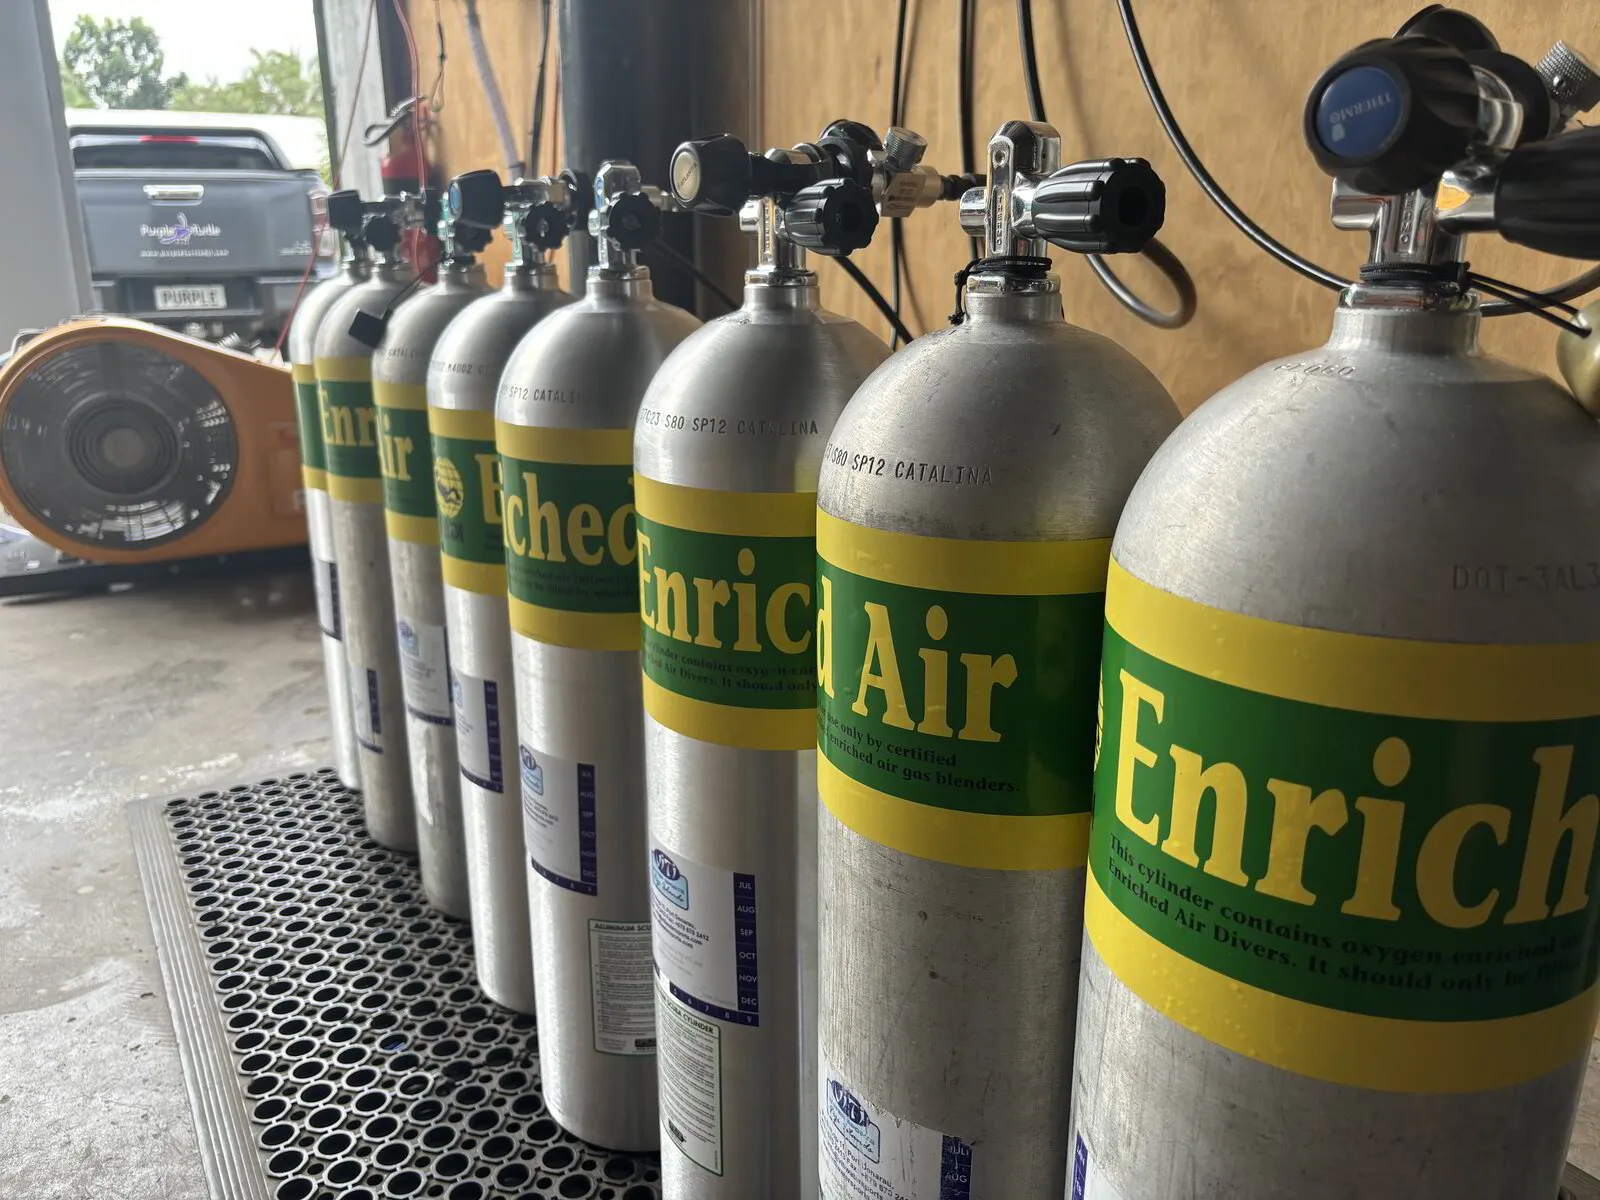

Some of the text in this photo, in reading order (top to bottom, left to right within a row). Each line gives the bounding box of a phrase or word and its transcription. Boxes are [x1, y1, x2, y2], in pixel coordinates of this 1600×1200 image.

[163, 289, 218, 307] PURPLE
[665, 414, 685, 430] S80
[692, 417, 727, 434] SP12
[737, 419, 819, 436] CATALINA
[852, 453, 884, 476] SP12
[895, 461, 993, 485] CATALINA
[637, 528, 812, 655] Enric
[681, 653, 733, 674] contains
[852, 601, 1019, 743] Air
[722, 676, 733, 688] It
[737, 678, 783, 692] should
[841, 723, 864, 744] only
[867, 732, 884, 752] by
[887, 743, 957, 768] certified
[830, 736, 1021, 793] enriched air gas blenders.
[1114, 668, 1600, 930] Enrich
[738, 881, 752, 890] JUL
[1110, 833, 1135, 869] This
[1138, 857, 1214, 913] cylinder
[1220, 901, 1333, 950] contains
[737, 905, 755, 914] AUG
[594, 922, 635, 932] ALUMINUM
[740, 928, 753, 937] SEP
[1107, 855, 1170, 916] Enriched
[1174, 906, 1206, 935] Air
[1213, 924, 1299, 968] Divers.
[1307, 955, 1329, 976] It
[1337, 957, 1433, 992] should
[1441, 972, 1498, 992] only
[739, 951, 756, 960] OCT
[738, 974, 757, 983] NOV
[741, 996, 757, 1006] DEC
[683, 1013, 714, 1035] CYLINDER
[725, 1011, 730, 1019] 8
[747, 1015, 752, 1023] 9
[944, 1173, 968, 1184] AUG
